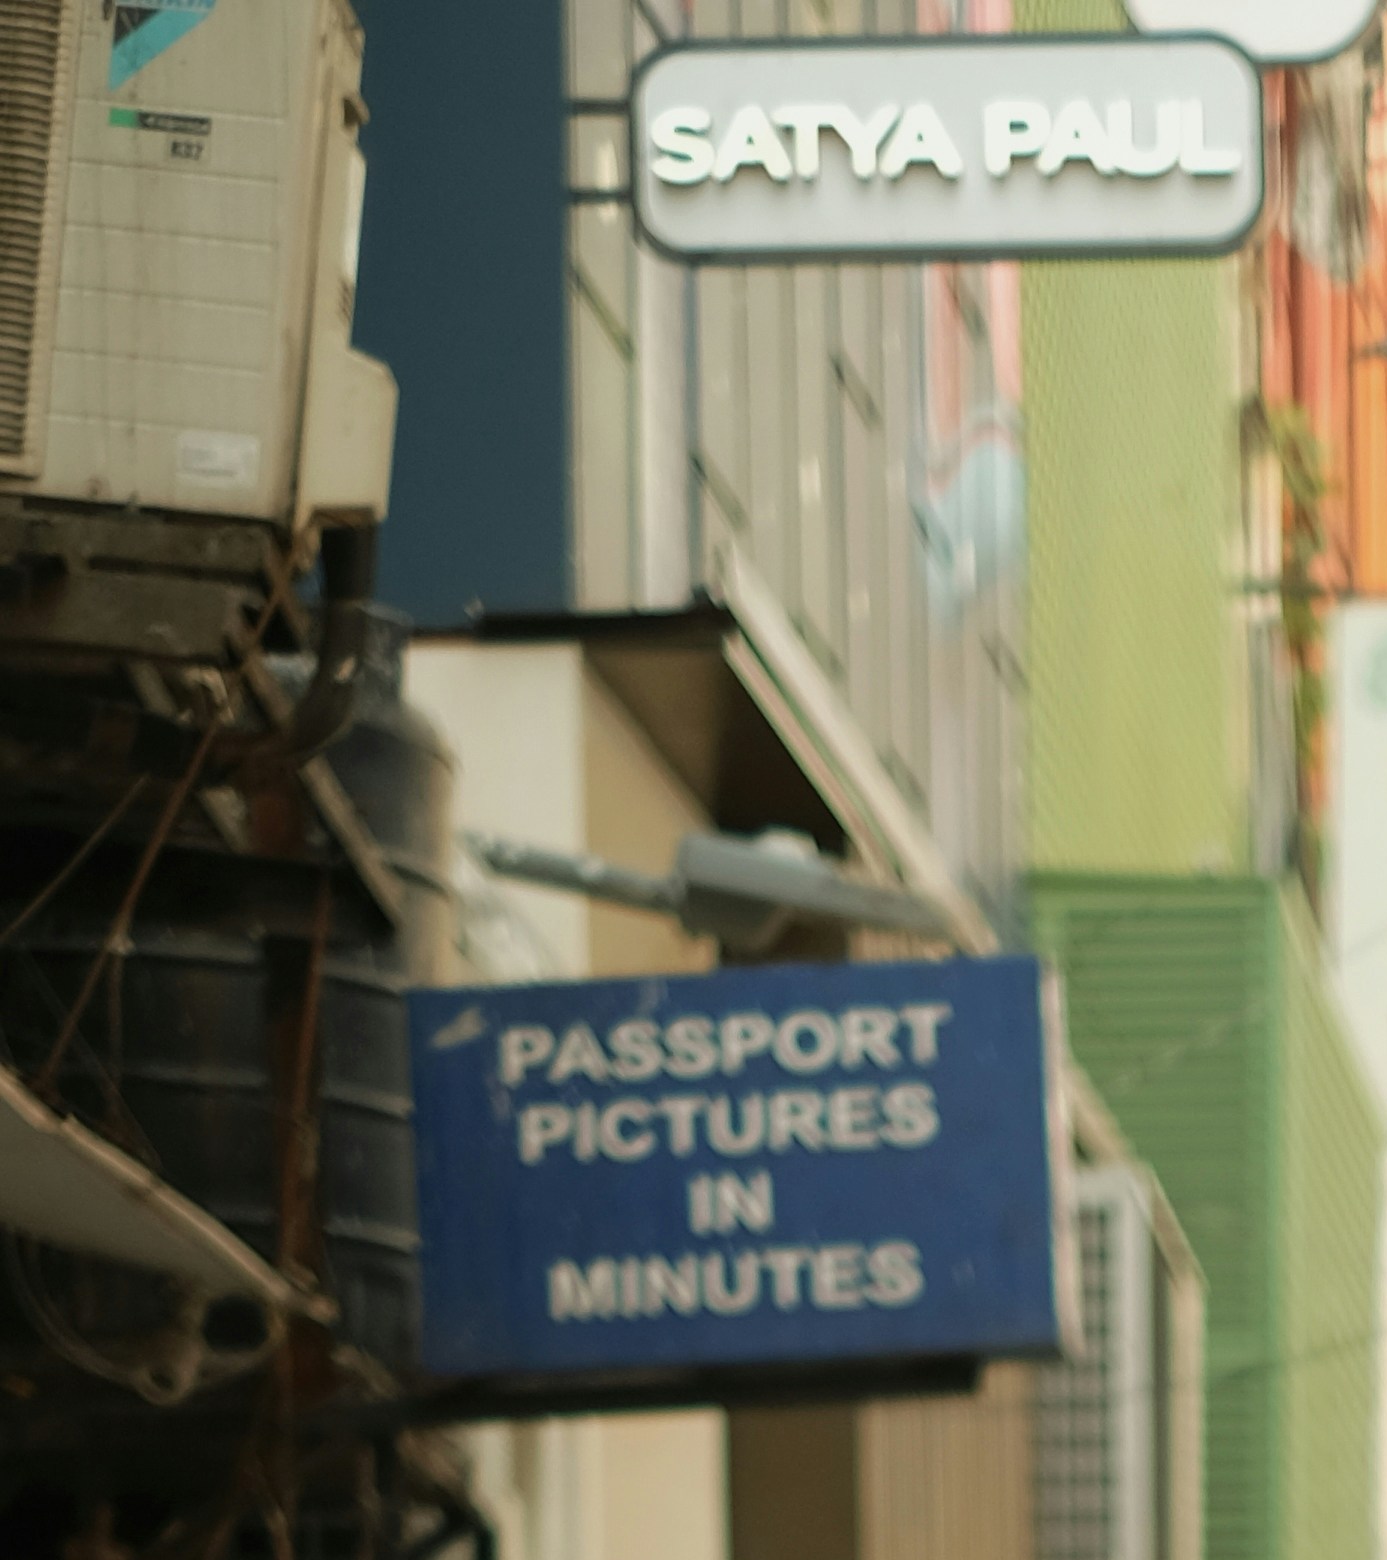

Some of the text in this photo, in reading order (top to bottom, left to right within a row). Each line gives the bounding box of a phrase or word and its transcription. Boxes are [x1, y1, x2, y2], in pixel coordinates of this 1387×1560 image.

[650, 99, 1241, 185] SATYA PAUL
[500, 1002, 953, 1089] PASSPORT
[519, 1082, 940, 1166] PICTURES
[688, 1169, 775, 1237] IN
[547, 1240, 924, 1323] MINUTES
